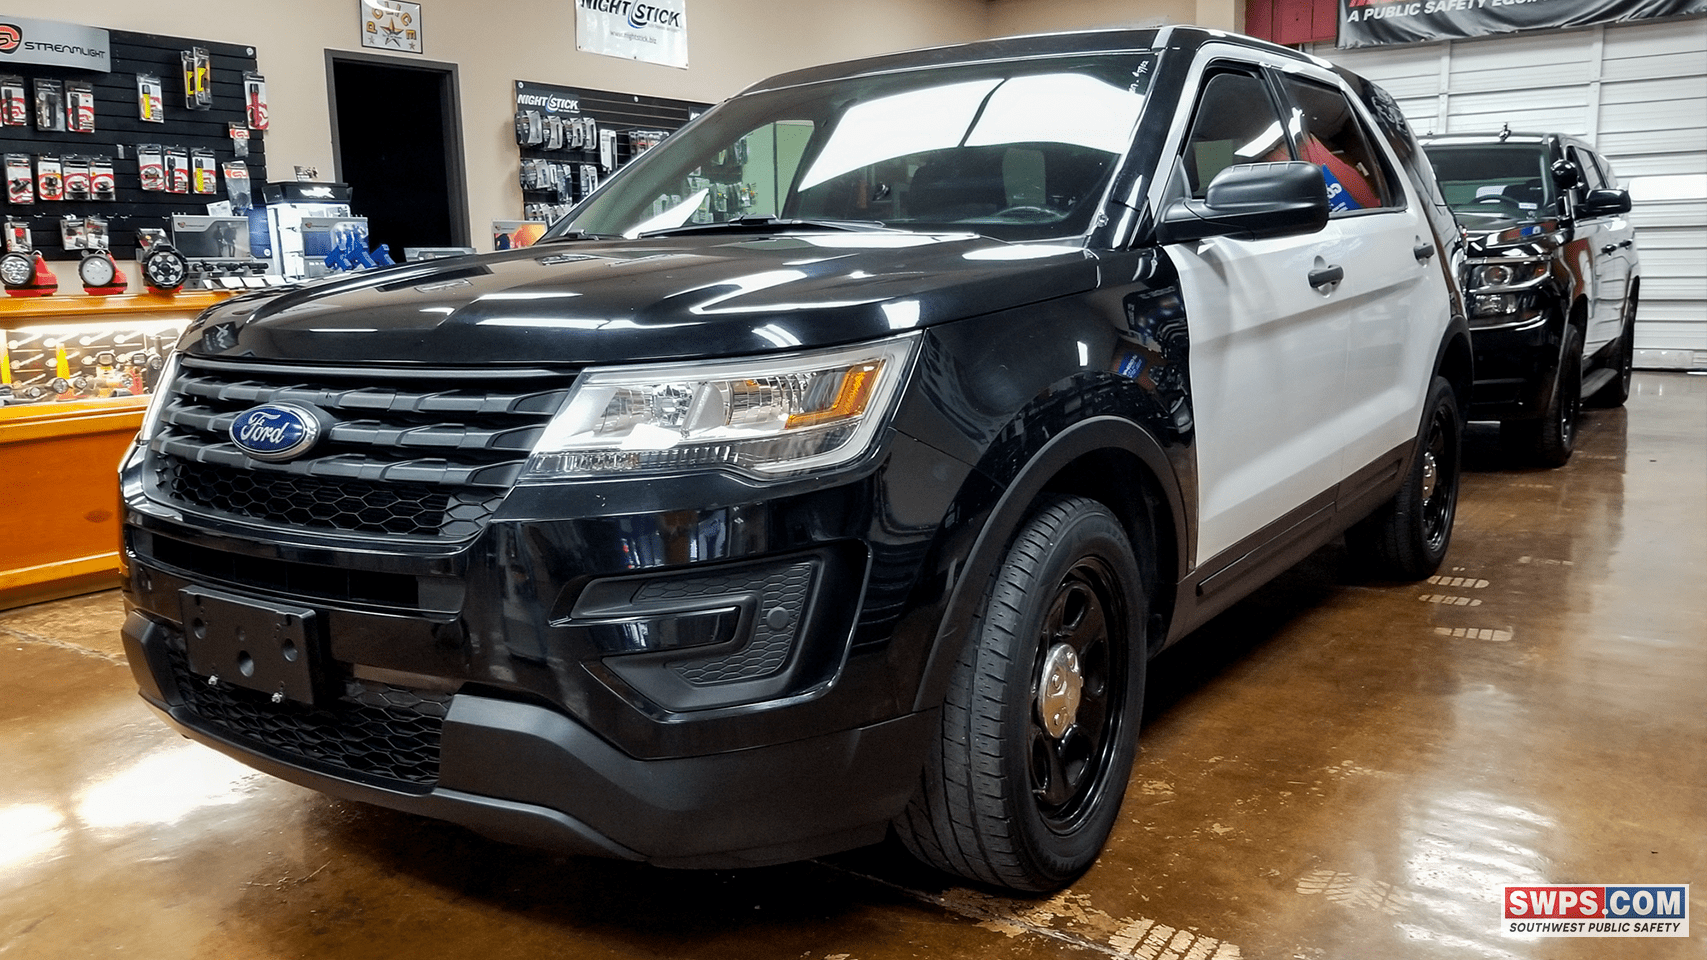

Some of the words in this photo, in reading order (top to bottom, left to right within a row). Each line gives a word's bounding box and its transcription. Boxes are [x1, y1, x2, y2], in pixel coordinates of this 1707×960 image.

[635, 4, 680, 27] STICK
[1347, 10, 1360, 23] A
[1363, 3, 1421, 21] PUBLIC
[1424, 0, 1485, 14] SAFETY
[24, 41, 105, 58] STREAMLIGHT
[517, 94, 549, 107] NIGHT
[550, 97, 579, 110] STICK
[240, 411, 290, 444] Ford
